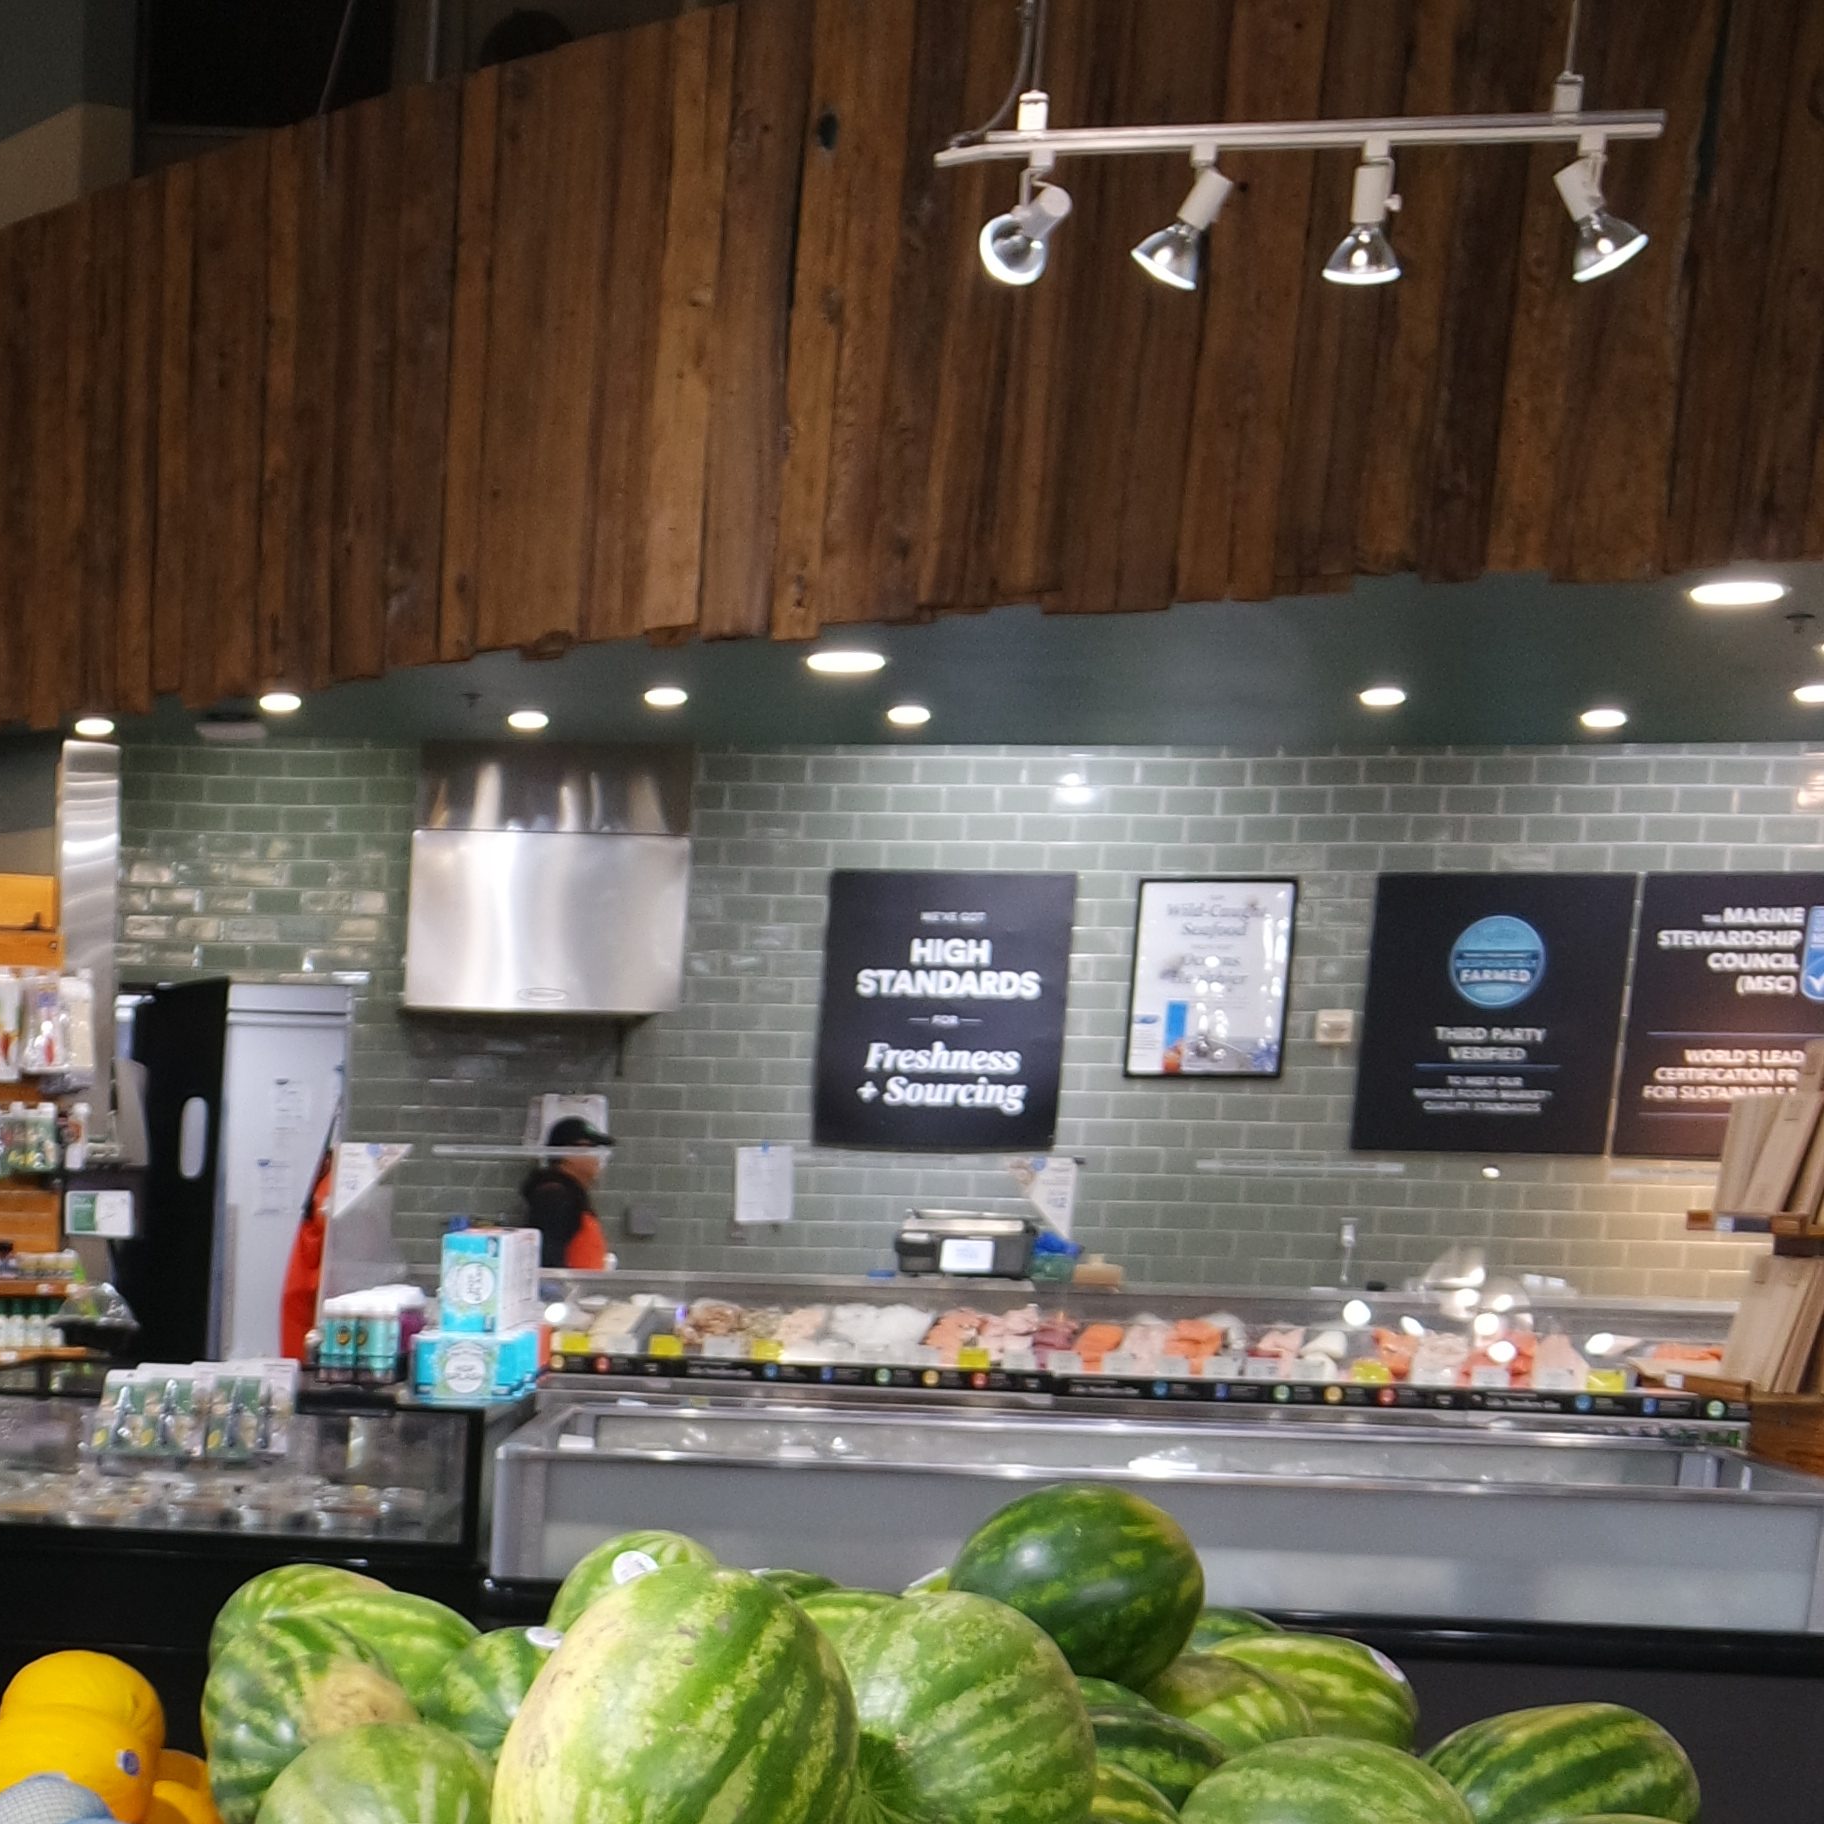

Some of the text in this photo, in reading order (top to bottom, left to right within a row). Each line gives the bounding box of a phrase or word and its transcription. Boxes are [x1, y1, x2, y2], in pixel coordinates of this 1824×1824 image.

[1723, 907, 1806, 925] MARINE
[1657, 930, 1803, 948] STEWARDSHIP
[910, 938, 992, 967] HIGH
[1707, 952, 1800, 971] COUNCIL
[856, 969, 1042, 999] STANDARDS
[1459, 969, 1532, 982] FARMED
[1736, 975, 1797, 995] (MSC)
[931, 1014, 959, 1025] FOR
[1434, 1026, 1547, 1042] THIRD PARTY
[864, 1041, 1023, 1075] Freshness
[1448, 1046, 1527, 1061] VERIFIED
[1684, 1049, 1807, 1064] WORLD'S LEAD
[1654, 1067, 1774, 1082] CERTIFICATION
[882, 1076, 1028, 1115] Sourcing
[1642, 1085, 1677, 1099] FOR
